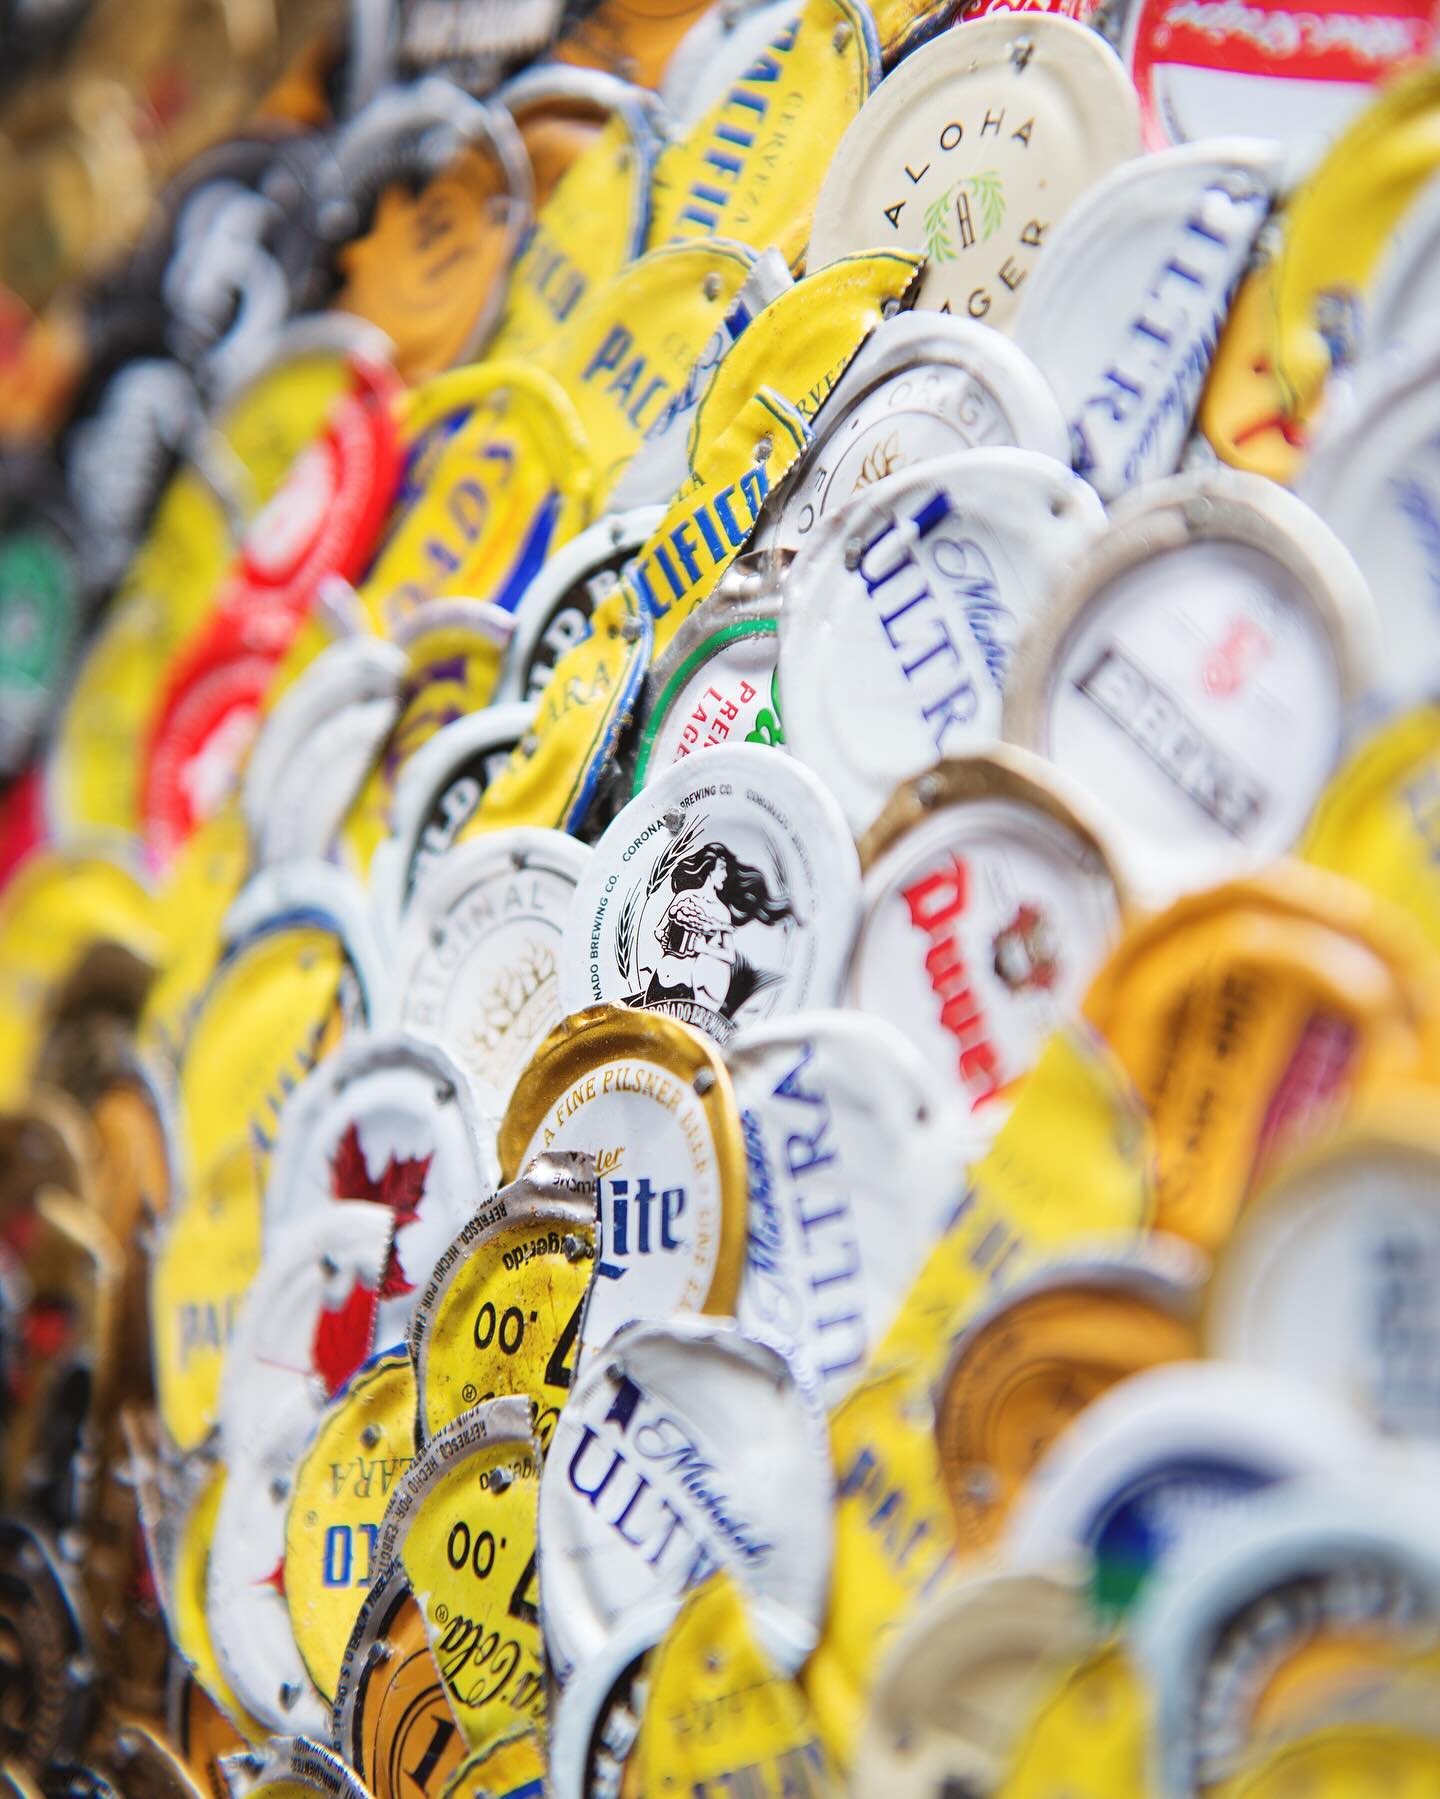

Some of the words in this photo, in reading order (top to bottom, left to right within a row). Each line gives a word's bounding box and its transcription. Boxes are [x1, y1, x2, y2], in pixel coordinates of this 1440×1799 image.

[884, 108, 1035, 229] ALOHA
[622, 815, 668, 862] CORONA
[590, 897, 608, 959] BREWING
[605, 875, 619, 892] CO.
[543, 1127, 555, 1147] A
[556, 1077, 596, 1127] FINE
[602, 1066, 684, 1115] PILSNER
[433, 1248, 461, 1282] HECHO
[407, 1455, 438, 1494] HECHO
